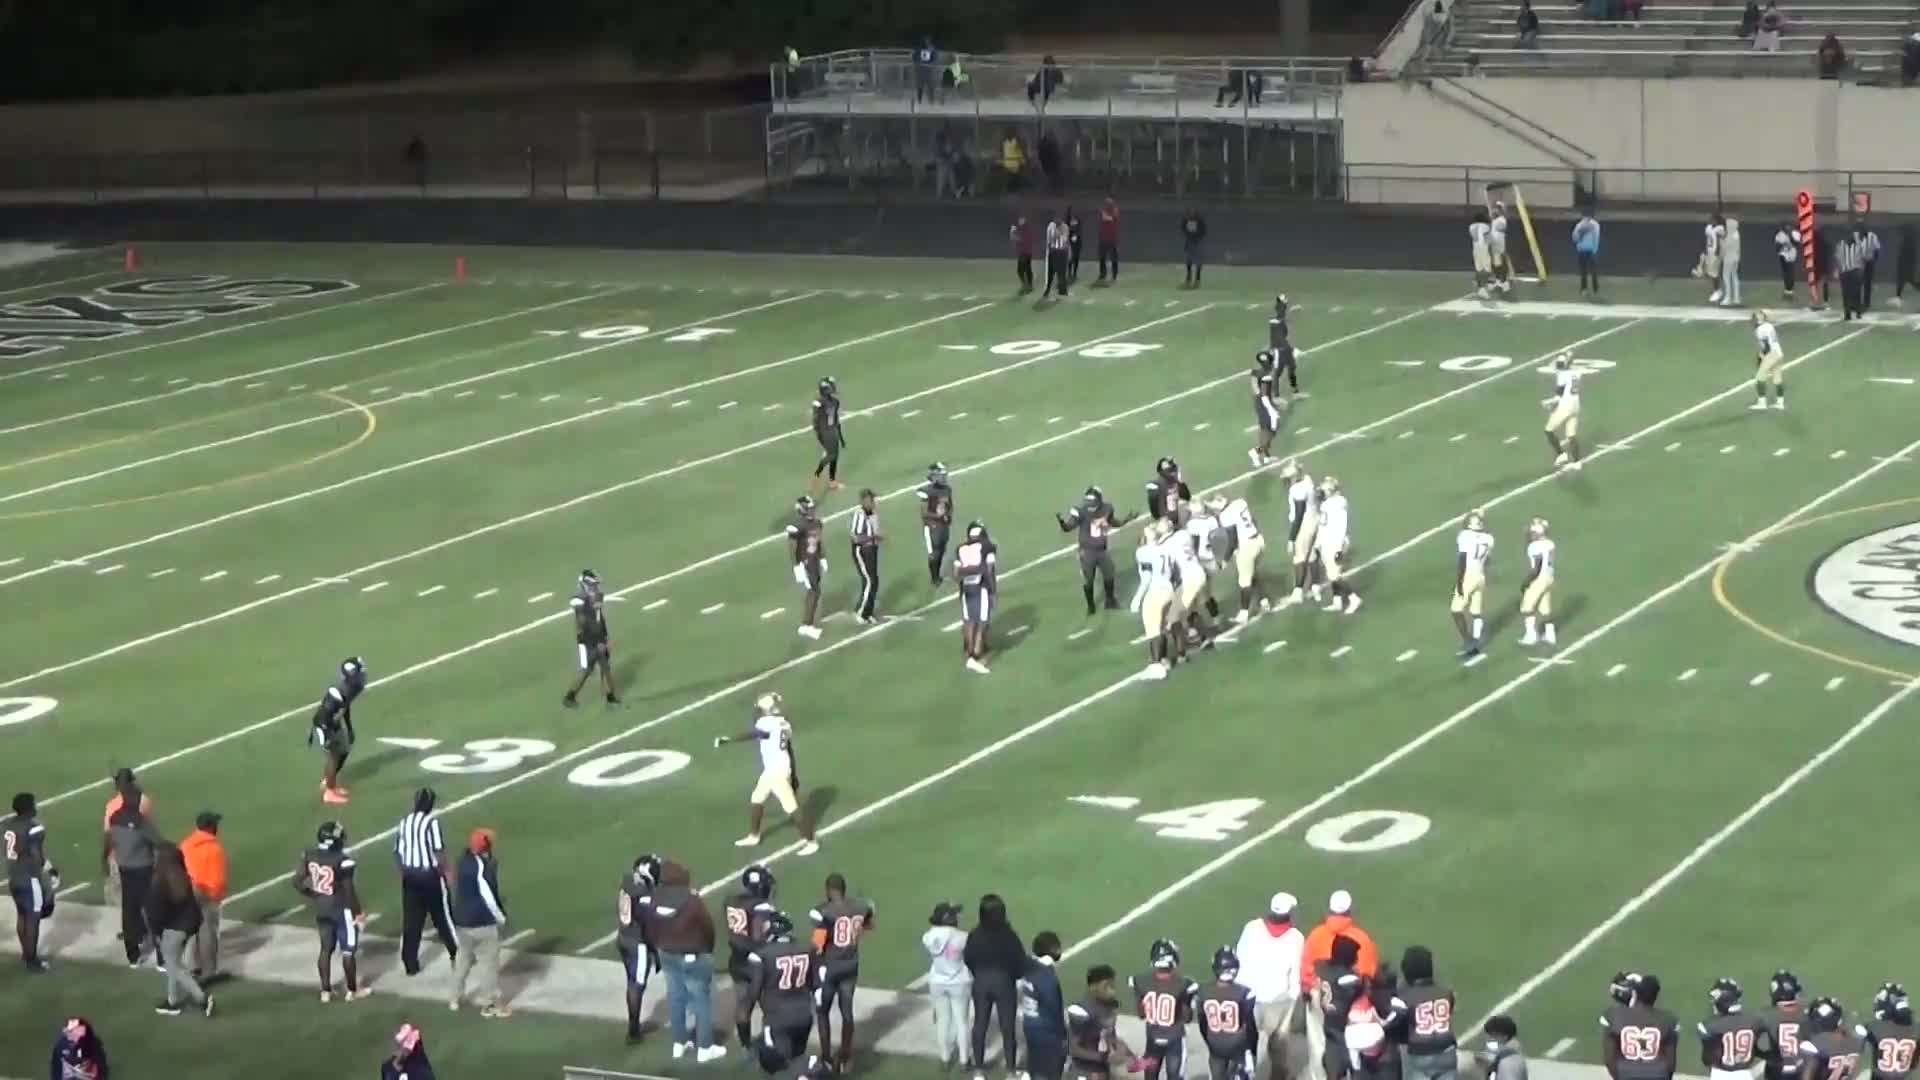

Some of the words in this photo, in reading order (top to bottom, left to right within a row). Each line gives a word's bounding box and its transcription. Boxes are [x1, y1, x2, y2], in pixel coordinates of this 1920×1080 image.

[419, 738, 692, 787] 30
[1136, 798, 1431, 852] 40
[776, 953, 810, 990] 77
[1143, 991, 1176, 1027] 10
[1415, 998, 1451, 1035] 59
[1620, 1025, 1661, 1061] 63
[1721, 1029, 1754, 1067] 19
[1877, 1037, 1916, 1073] 33
